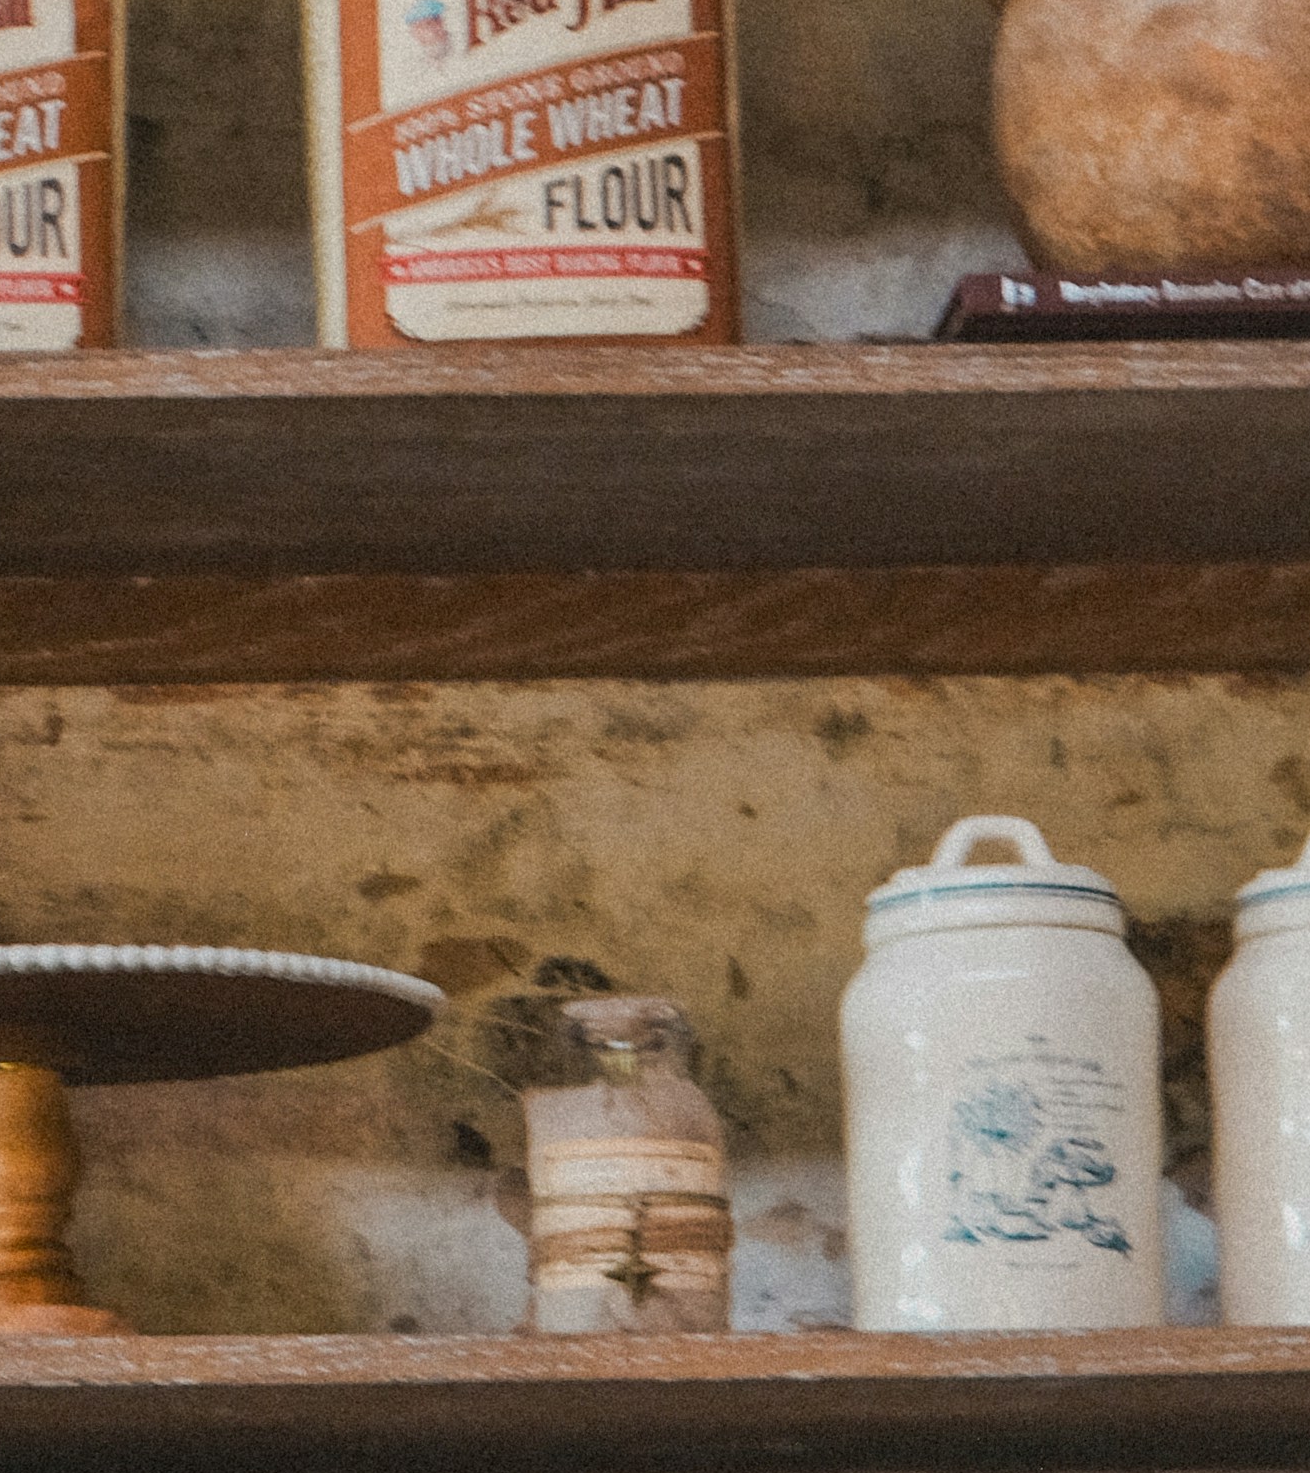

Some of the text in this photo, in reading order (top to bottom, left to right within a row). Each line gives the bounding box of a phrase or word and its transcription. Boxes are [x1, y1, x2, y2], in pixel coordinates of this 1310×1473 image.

[393, 78, 688, 196] WHOLE WHEAT
[542, 155, 694, 234] FLOUR
